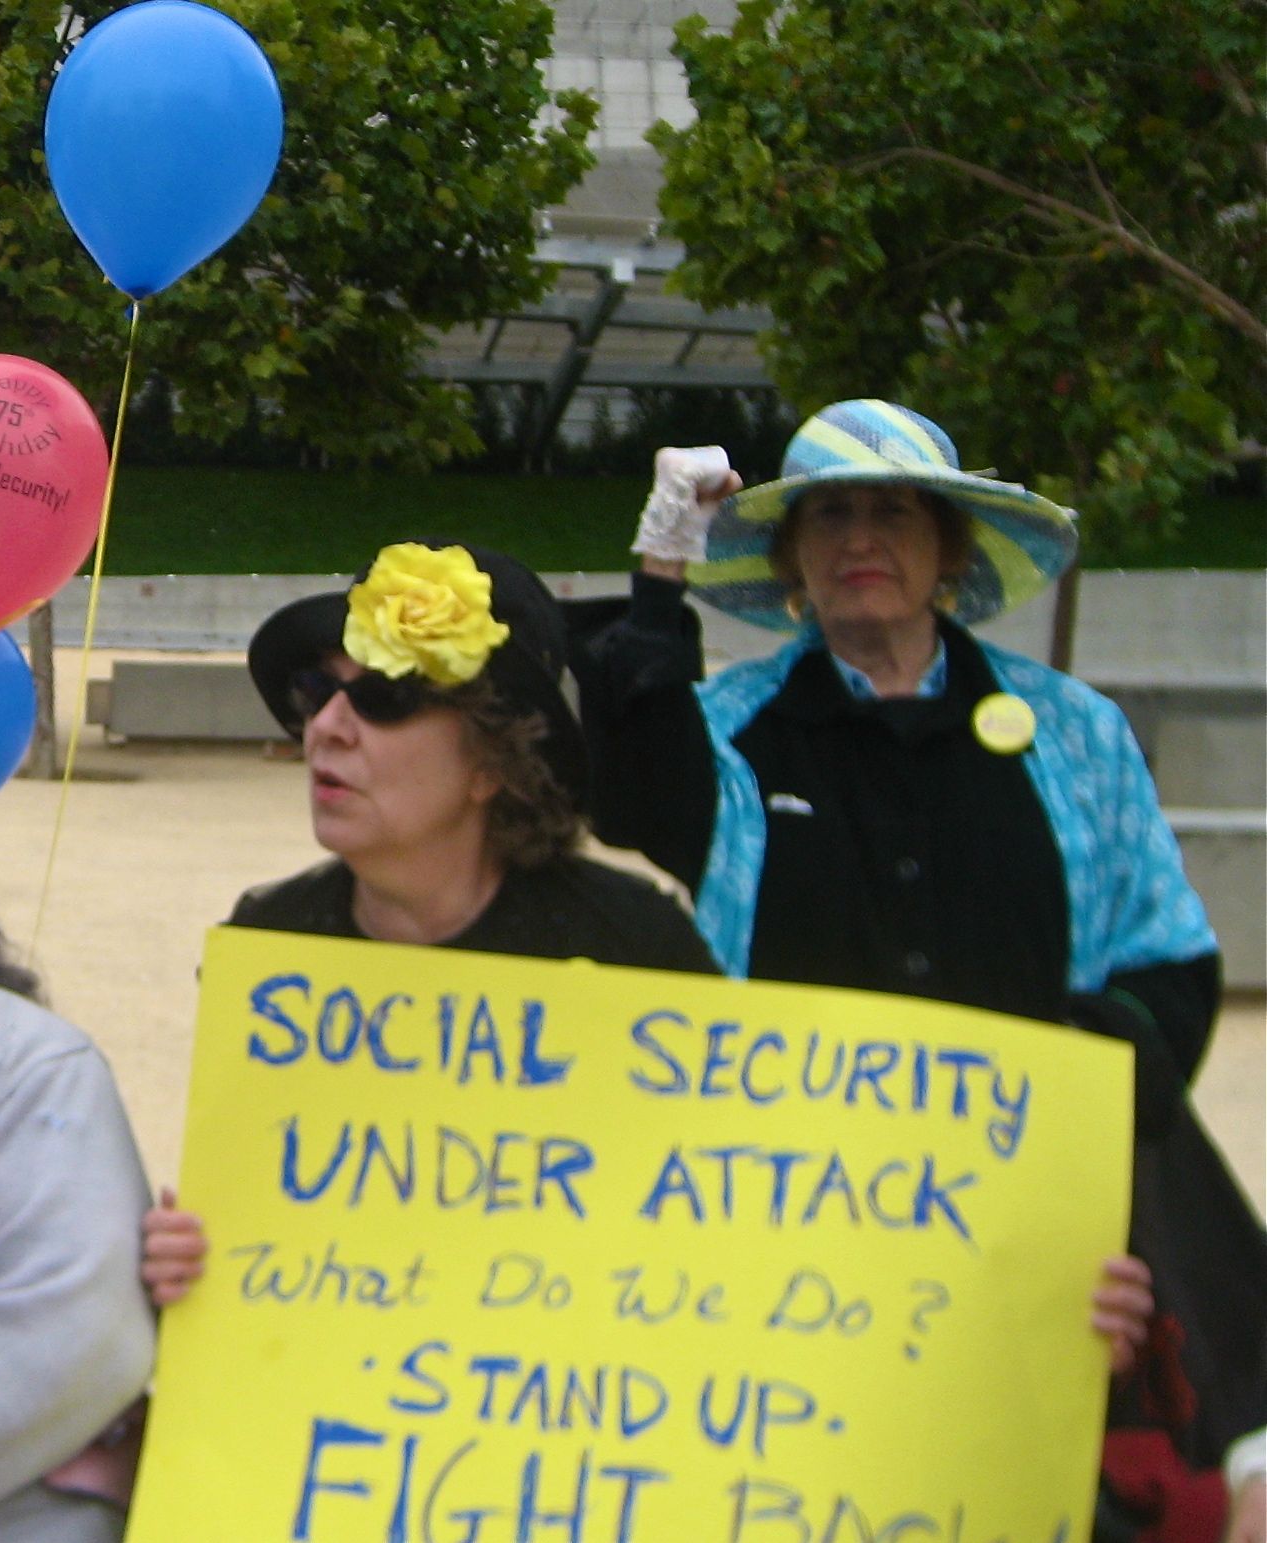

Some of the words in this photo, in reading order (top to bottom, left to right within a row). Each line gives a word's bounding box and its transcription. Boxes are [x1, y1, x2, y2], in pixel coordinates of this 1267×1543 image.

[247, 972, 577, 1087] SOCIAL
[276, 1115, 596, 1221] UNDER
[638, 1143, 982, 1256] ATTACK
[227, 1239, 435, 1310] What
[478, 1250, 573, 1309] Do
[610, 1265, 728, 1325] We
[765, 1267, 874, 1338] Do
[698, 1372, 845, 1460] UP.
[292, 1415, 671, 1543] FIGHT
